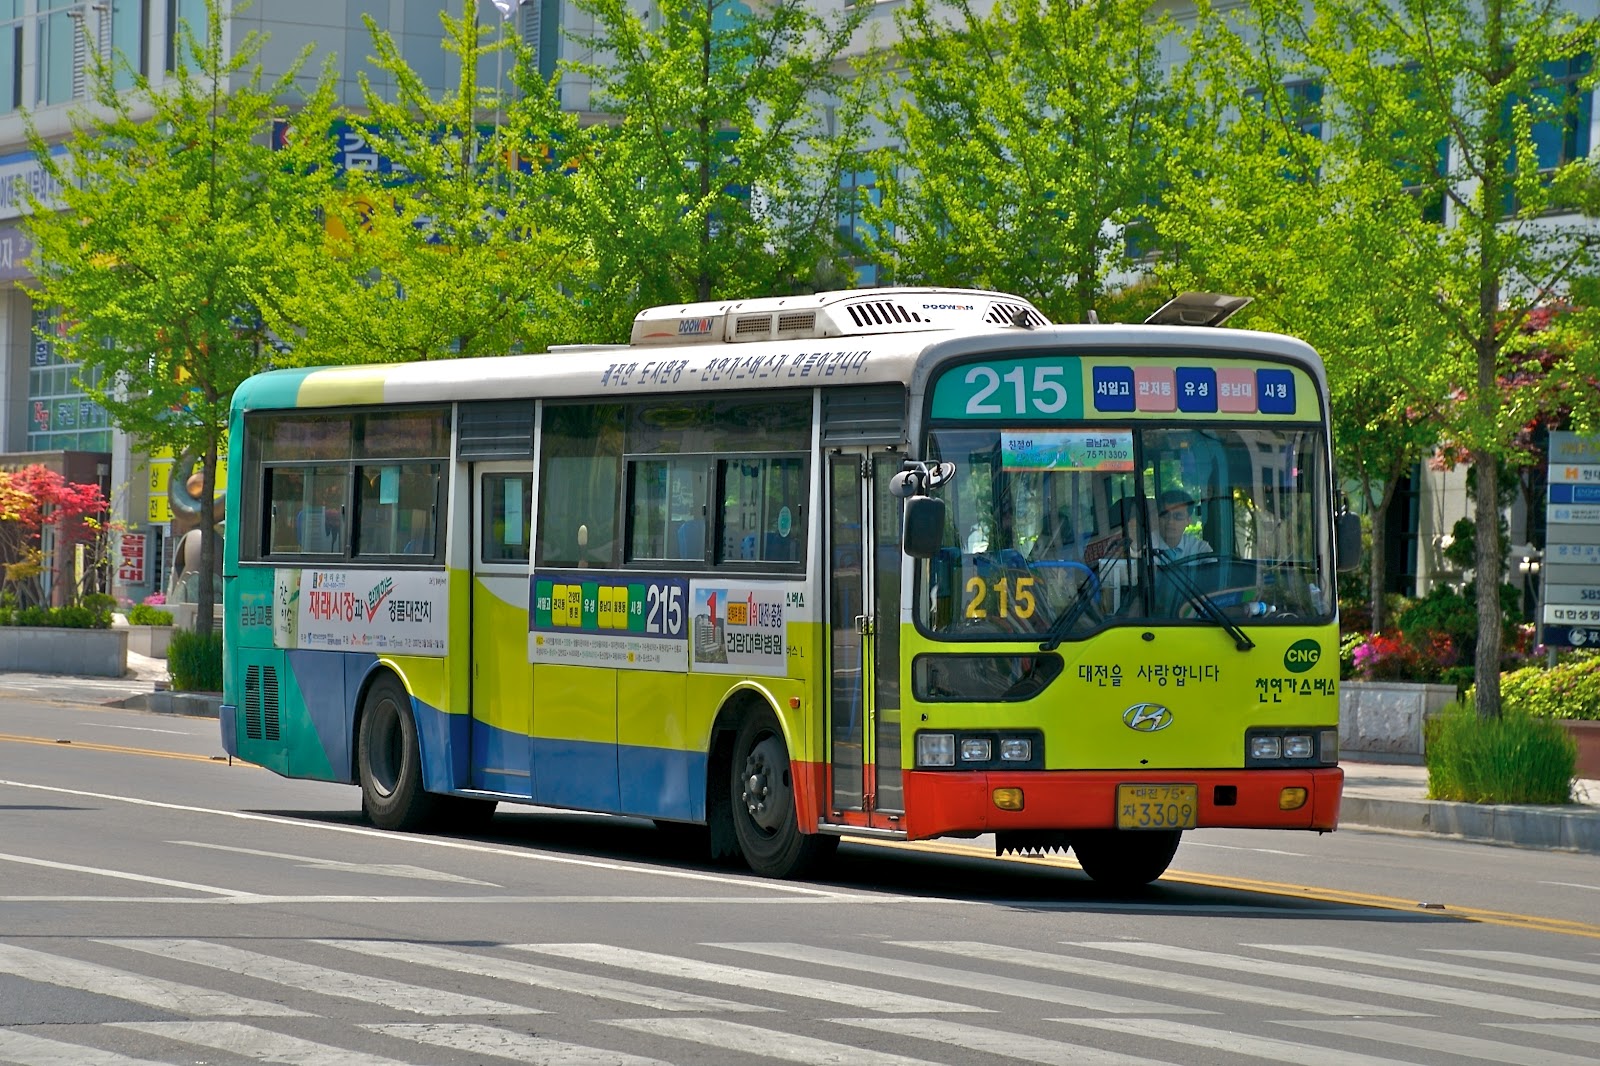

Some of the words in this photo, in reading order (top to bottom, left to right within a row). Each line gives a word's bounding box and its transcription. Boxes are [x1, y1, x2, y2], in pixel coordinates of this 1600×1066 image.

[678, 318, 713, 333] DOOWON
[637, 359, 689, 384] 도시환경
[701, 354, 789, 382] 천연가스버스가
[965, 366, 1067, 414] 215
[1097, 381, 1130, 396] 서일고
[1138, 381, 1172, 396] 관저동
[1184, 382, 1209, 397] 유성
[1220, 383, 1252, 397] 충남대
[1264, 382, 1288, 398] 시청
[1086, 438, 1117, 448] 금남교통
[1086, 450, 1096, 459] 75
[1108, 450, 1128, 459] 3309
[536, 597, 551, 610] 서일고
[584, 598, 595, 613] 유성
[965, 577, 1036, 619] 215
[308, 591, 364, 622] 재래시장과
[388, 600, 432, 623] 경품대잔치
[630, 600, 642, 615] 시청
[646, 584, 682, 635] 215
[1554, 609, 1600, 620] 대한생명
[241, 605, 273, 626] 금남교통
[726, 632, 782, 655] 건양대학병원
[1286, 648, 1320, 663] CNG
[1079, 664, 1123, 687] 대전을
[1136, 664, 1220, 687] 사랑합니다
[1255, 678, 1335, 704] 천연가스버스
[1135, 788, 1158, 800] 대전
[1161, 788, 1180, 800] 75
[1123, 803, 1137, 819] 자
[1139, 803, 1192, 826] 3309
